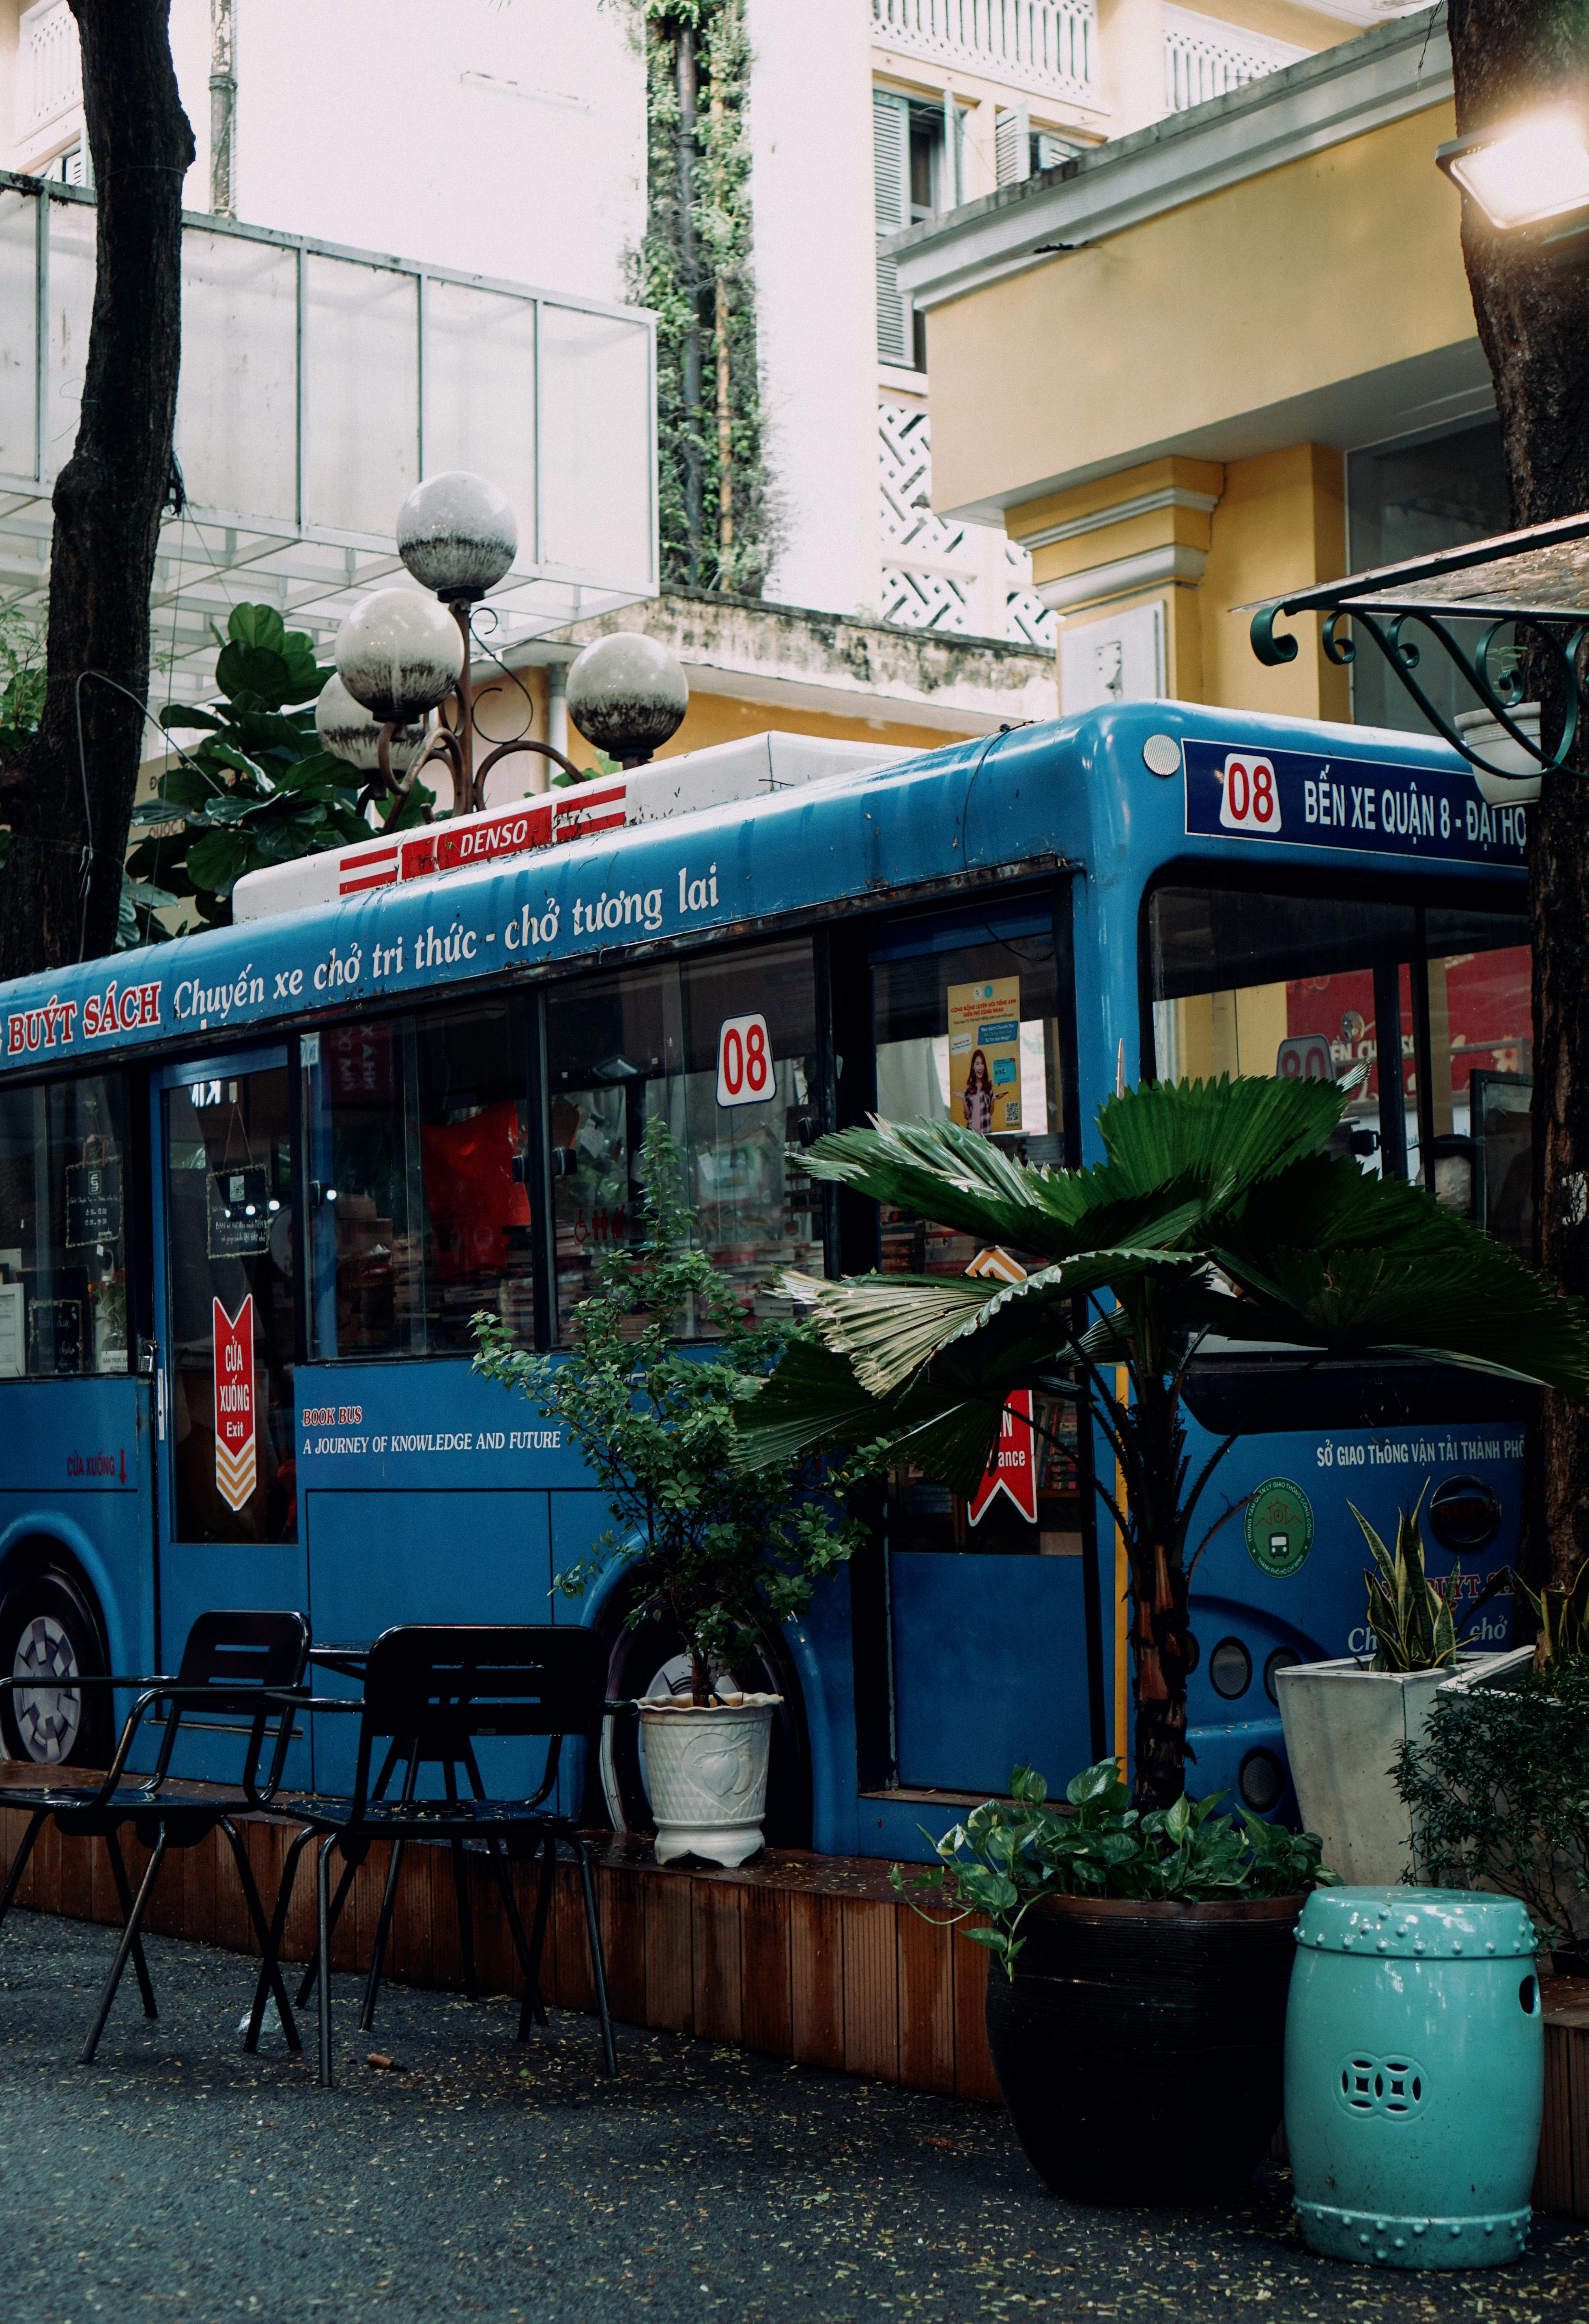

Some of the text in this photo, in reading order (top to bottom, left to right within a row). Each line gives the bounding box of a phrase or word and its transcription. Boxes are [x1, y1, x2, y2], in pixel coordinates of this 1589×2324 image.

[1229, 763, 1273, 823] 08
[1304, 765, 1345, 826] BẾN
[1351, 786, 1376, 830] XE
[1382, 782, 1434, 844] QUẬN
[1440, 796, 1451, 839] 8
[1466, 800, 1496, 851] ĐẠI
[460, 819, 527, 858] DENSO
[174, 963, 264, 1019] Chuyến
[273, 969, 303, 1000] xe
[313, 942, 362, 990] chở
[372, 937, 403, 978] tri
[415, 922, 477, 970] thức
[504, 897, 560, 950] chở
[572, 888, 664, 930] tương
[678, 862, 719, 914] lai
[7, 980, 162, 1055] BUÝT SÁCH
[724, 1024, 766, 1094] 08
[225, 1335, 243, 1372] CỬA
[220, 1374, 249, 1412] XUỐNG
[226, 1421, 243, 1437] Exit
[302, 1405, 362, 1427] BOOK BUS
[303, 1431, 561, 1454] A JOURNEY OF KNOWLEDGE AND FUTURE
[1317, 1439, 1333, 1467] SỞ
[1337, 1445, 1365, 1466] GIAO
[1368, 1439, 1408, 1464] THÔNG
[1411, 1438, 1435, 1466] VẬN
[1438, 1434, 1458, 1461] TẢI
[1460, 1436, 1500, 1460] THÀNH
[67, 1449, 115, 1476] CỬA XUỐNG
[1286, 1483, 1301, 1499] THÔNG
[1301, 1498, 1309, 1517] CÔNG
[1469, 1615, 1508, 1641] chở
